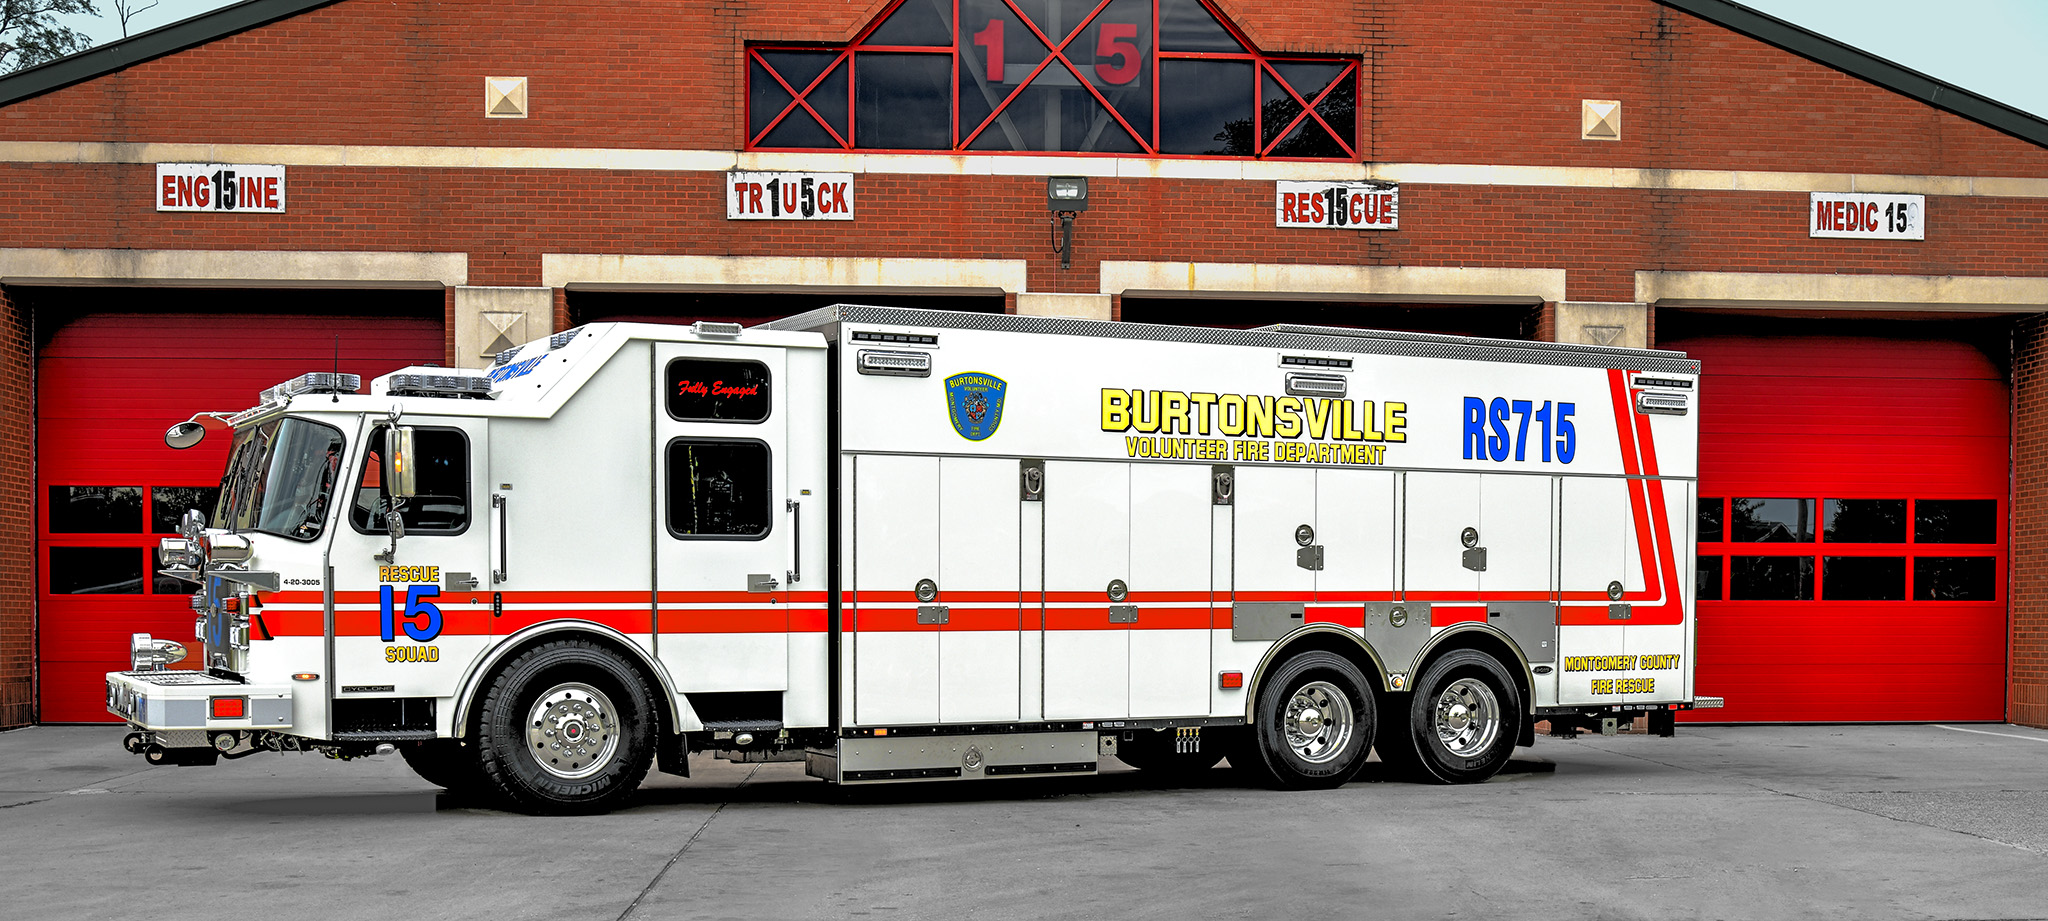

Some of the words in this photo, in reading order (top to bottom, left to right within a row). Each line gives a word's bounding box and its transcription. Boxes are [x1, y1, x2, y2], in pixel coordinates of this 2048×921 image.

[1817, 200, 1879, 232] MEDIC
[1885, 202, 1908, 233] 15
[678, 380, 708, 397] Fully
[711, 380, 759, 399] Engaged
[949, 376, 1003, 391] BURTONSVILLE
[1101, 387, 1407, 443] BURTONSVILLE
[1462, 396, 1576, 465] RS715
[1125, 436, 1228, 461] VOLUNTEER
[1233, 440, 1269, 462] FIRE
[1274, 442, 1386, 466] DEPARTMENT
[283, 578, 321, 586] 4-20-3005
[379, 565, 440, 582] RESCUE
[380, 585, 444, 643] 15
[1564, 655, 1638, 672] MONTGOMERY
[1640, 654, 1681, 670] COUNTY
[1591, 679, 1613, 695] FIRE
[1615, 678, 1655, 694] RESCUE
[535, 774, 612, 796] MICHELIN
